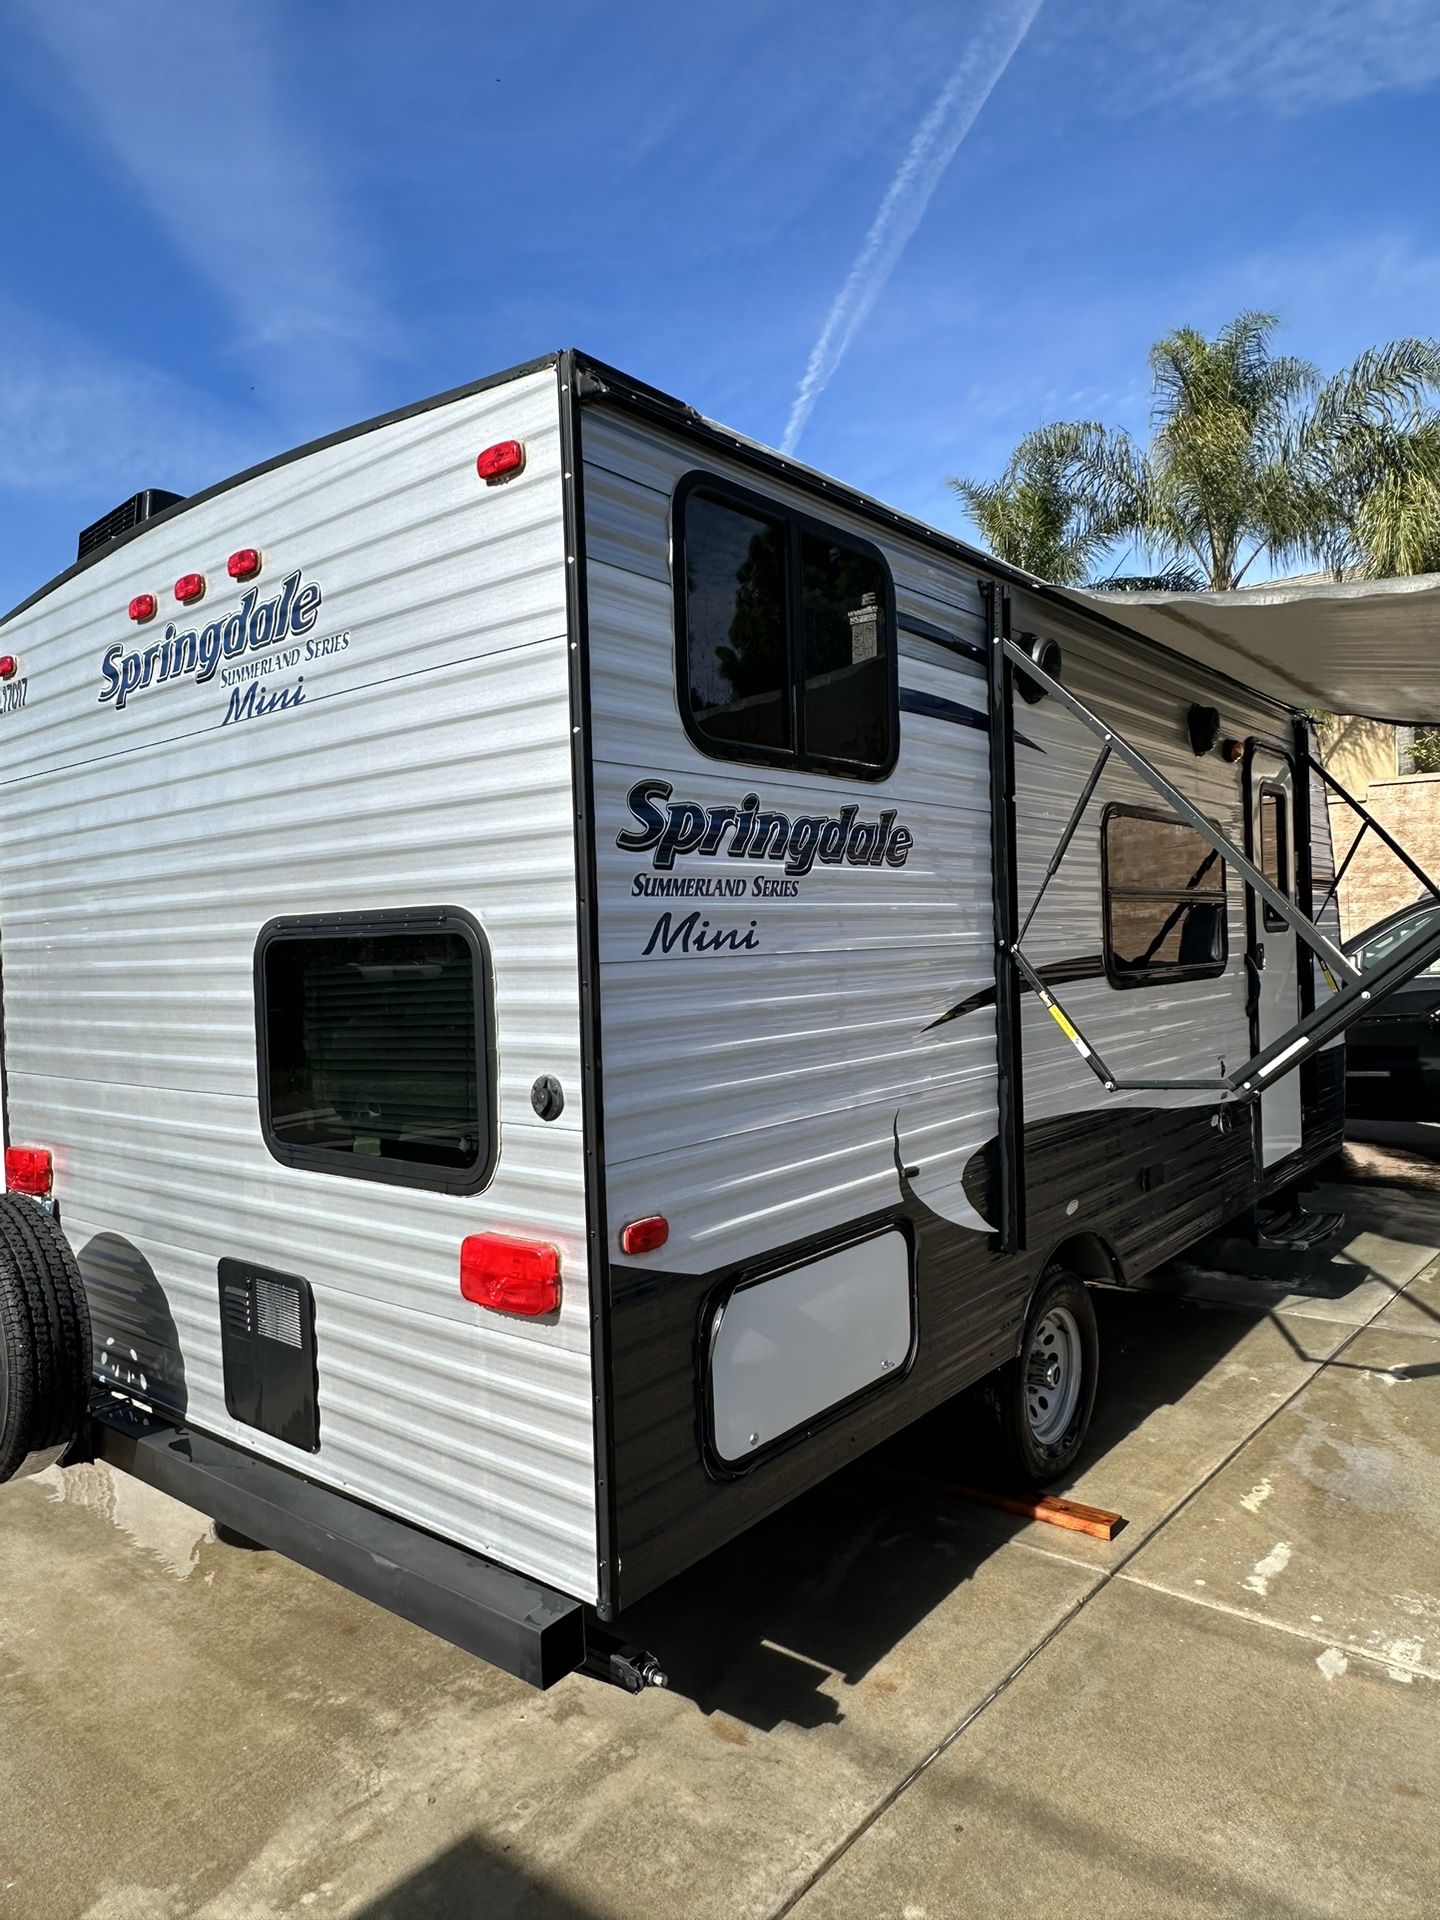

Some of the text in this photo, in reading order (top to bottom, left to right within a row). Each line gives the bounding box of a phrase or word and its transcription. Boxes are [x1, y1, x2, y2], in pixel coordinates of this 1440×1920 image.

[98, 569, 322, 710] Springdale
[220, 631, 350, 688] SUMMERLAND SERIES
[222, 676, 306, 726] Mini
[615, 778, 914, 876] Springdale
[631, 873, 799, 897] SUMMERLAND SERIES
[641, 911, 760, 954] Mini
